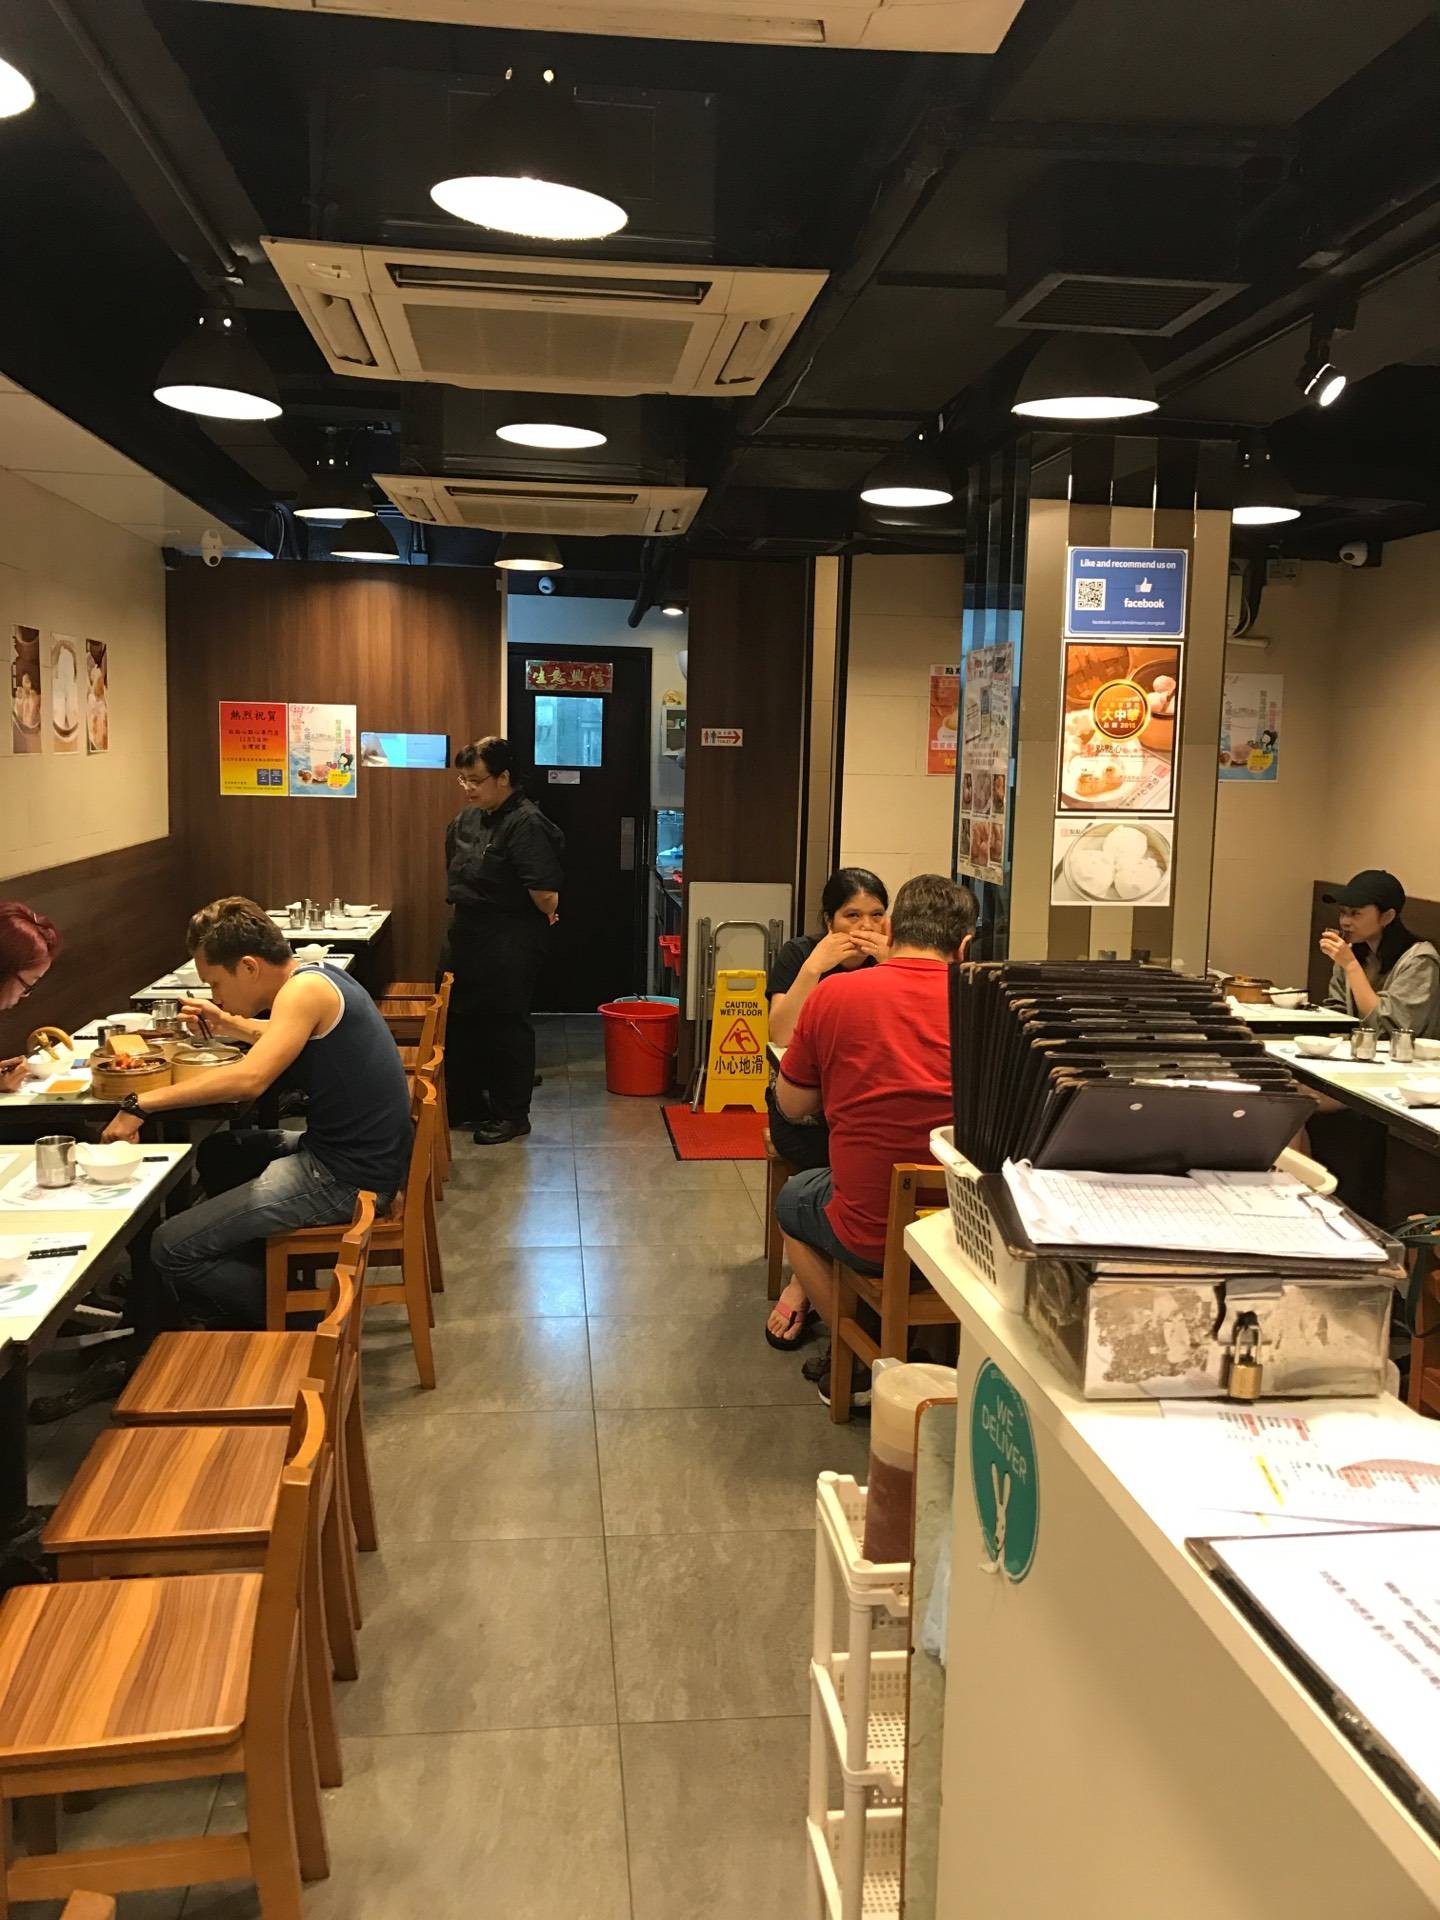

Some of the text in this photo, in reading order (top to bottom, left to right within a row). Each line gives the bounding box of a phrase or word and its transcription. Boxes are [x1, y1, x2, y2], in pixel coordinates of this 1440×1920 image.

[1080, 558, 1096, 568] Like
[1096, 559, 1111, 568] and
[1111, 560, 1156, 569] recommend
[1124, 598, 1165, 609] facebook
[725, 1001, 758, 1009] CAUTION
[715, 1055, 763, 1075] 小心地滑
[997, 1394, 1014, 1438] WE
[982, 1403, 1027, 1485] DELIVER
